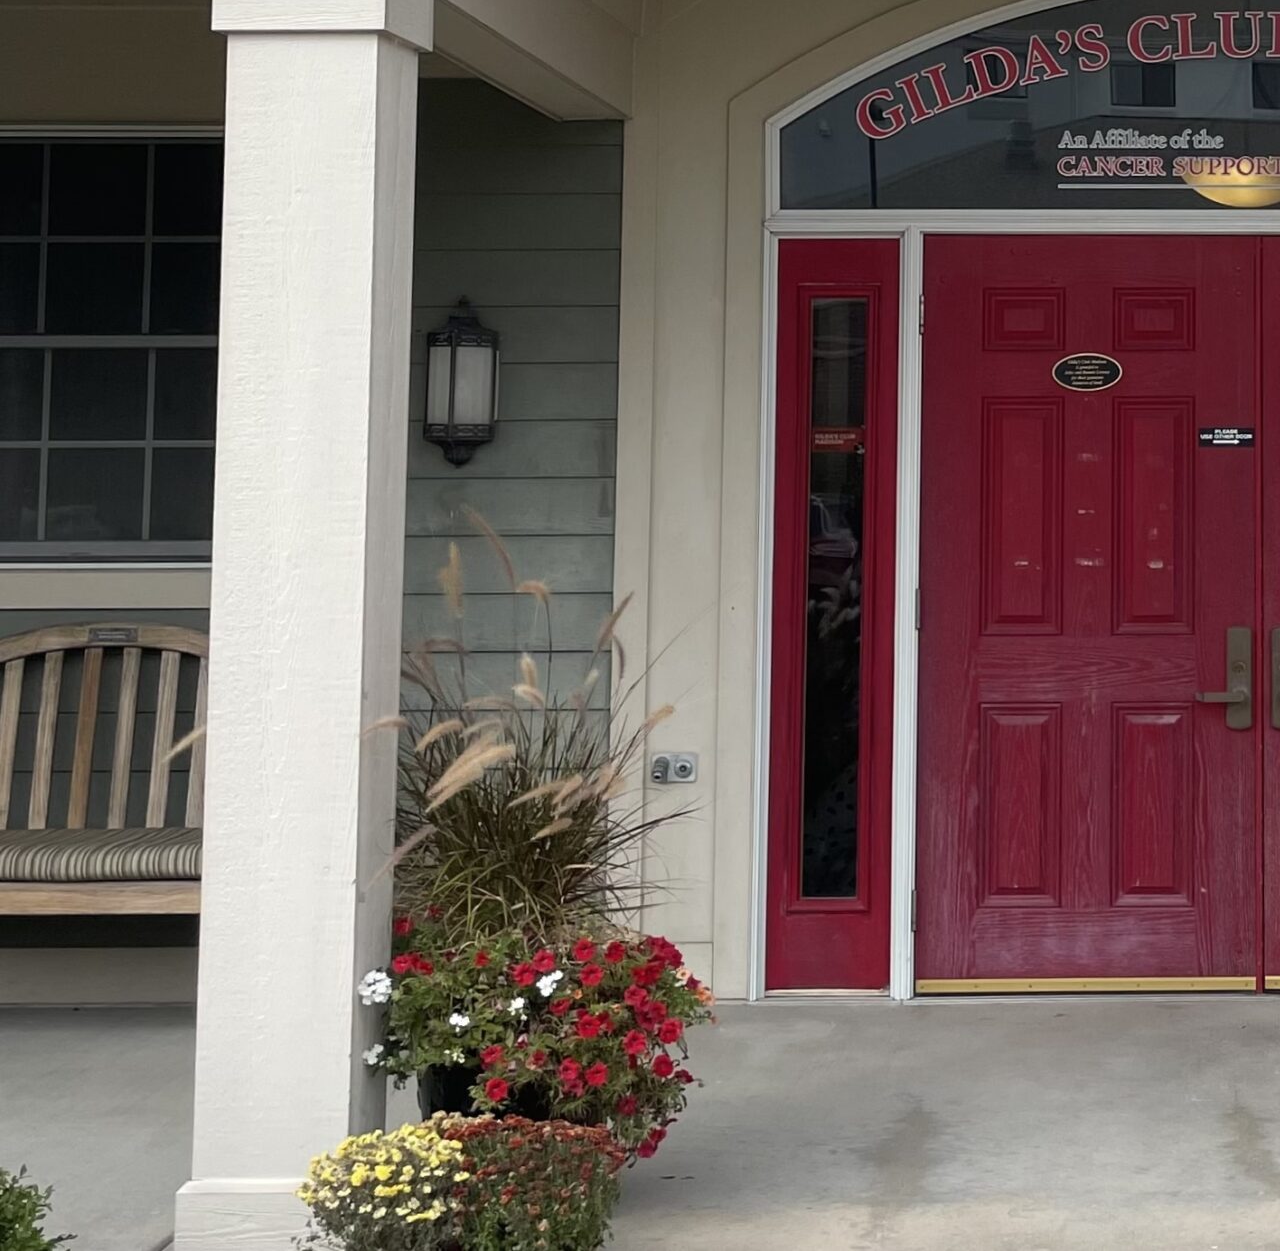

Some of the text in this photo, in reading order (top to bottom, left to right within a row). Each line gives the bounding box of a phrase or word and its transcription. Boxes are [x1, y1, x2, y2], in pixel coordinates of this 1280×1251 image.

[856, 23, 1111, 140] GILDA'S
[1057, 129, 1224, 149] An Affiliate of the
[1057, 156, 1166, 177] CANCER
